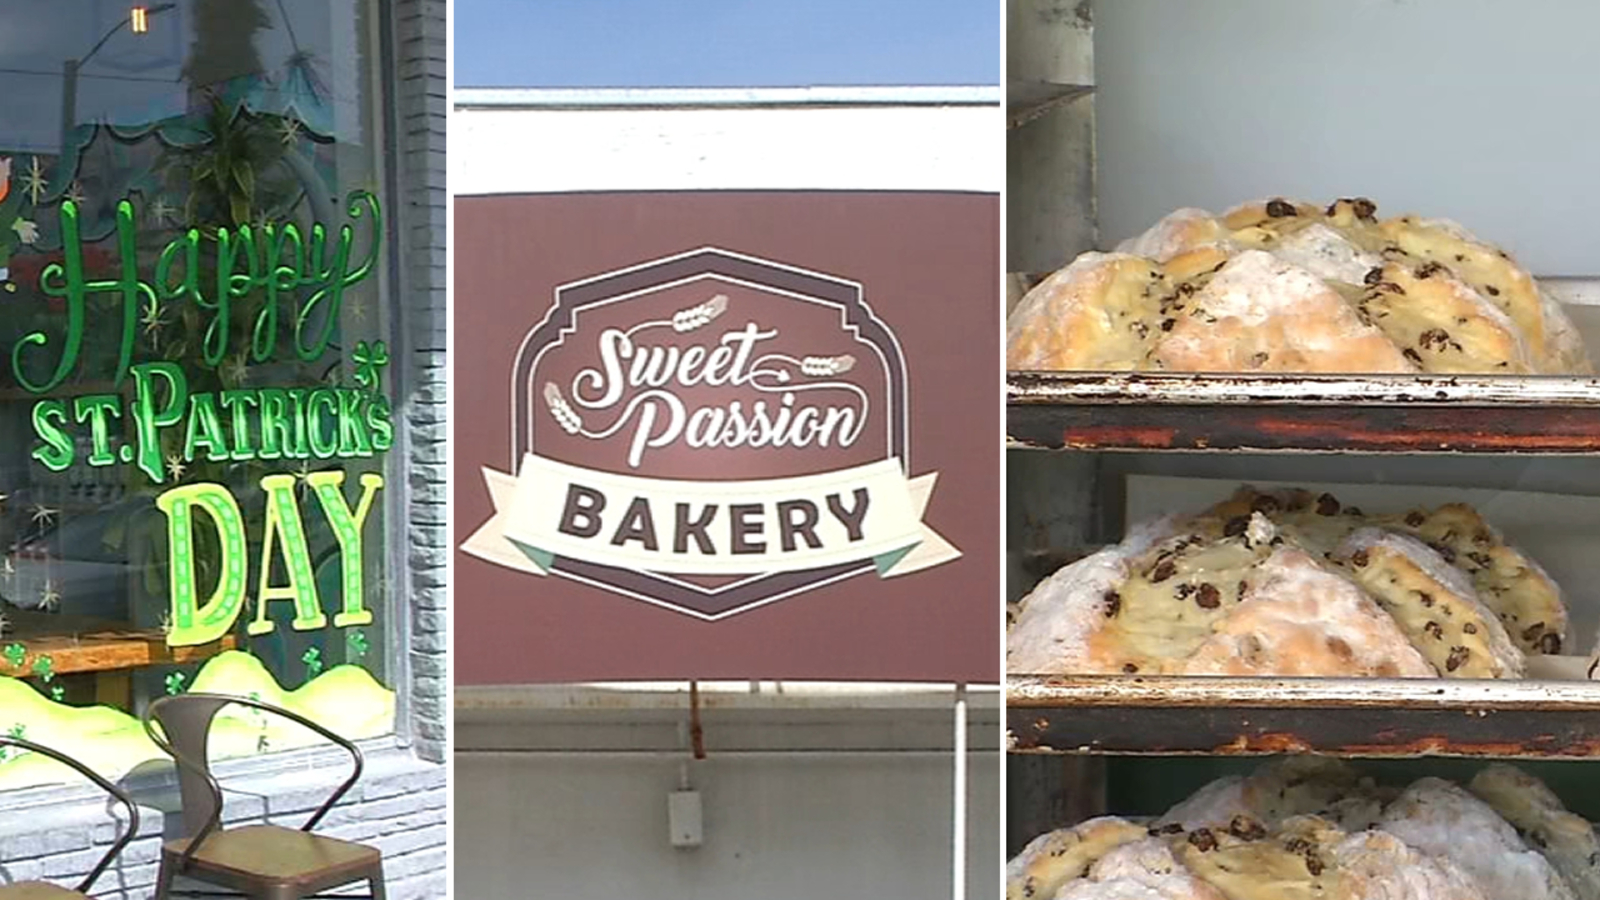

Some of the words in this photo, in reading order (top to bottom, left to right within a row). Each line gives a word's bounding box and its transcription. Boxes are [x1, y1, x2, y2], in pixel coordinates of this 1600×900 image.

[12, 191, 382, 393] Happy
[572, 323, 778, 408] Sweet
[628, 390, 868, 467] Passion
[156, 471, 383, 647] DAY
[557, 482, 871, 555] BAKERY
